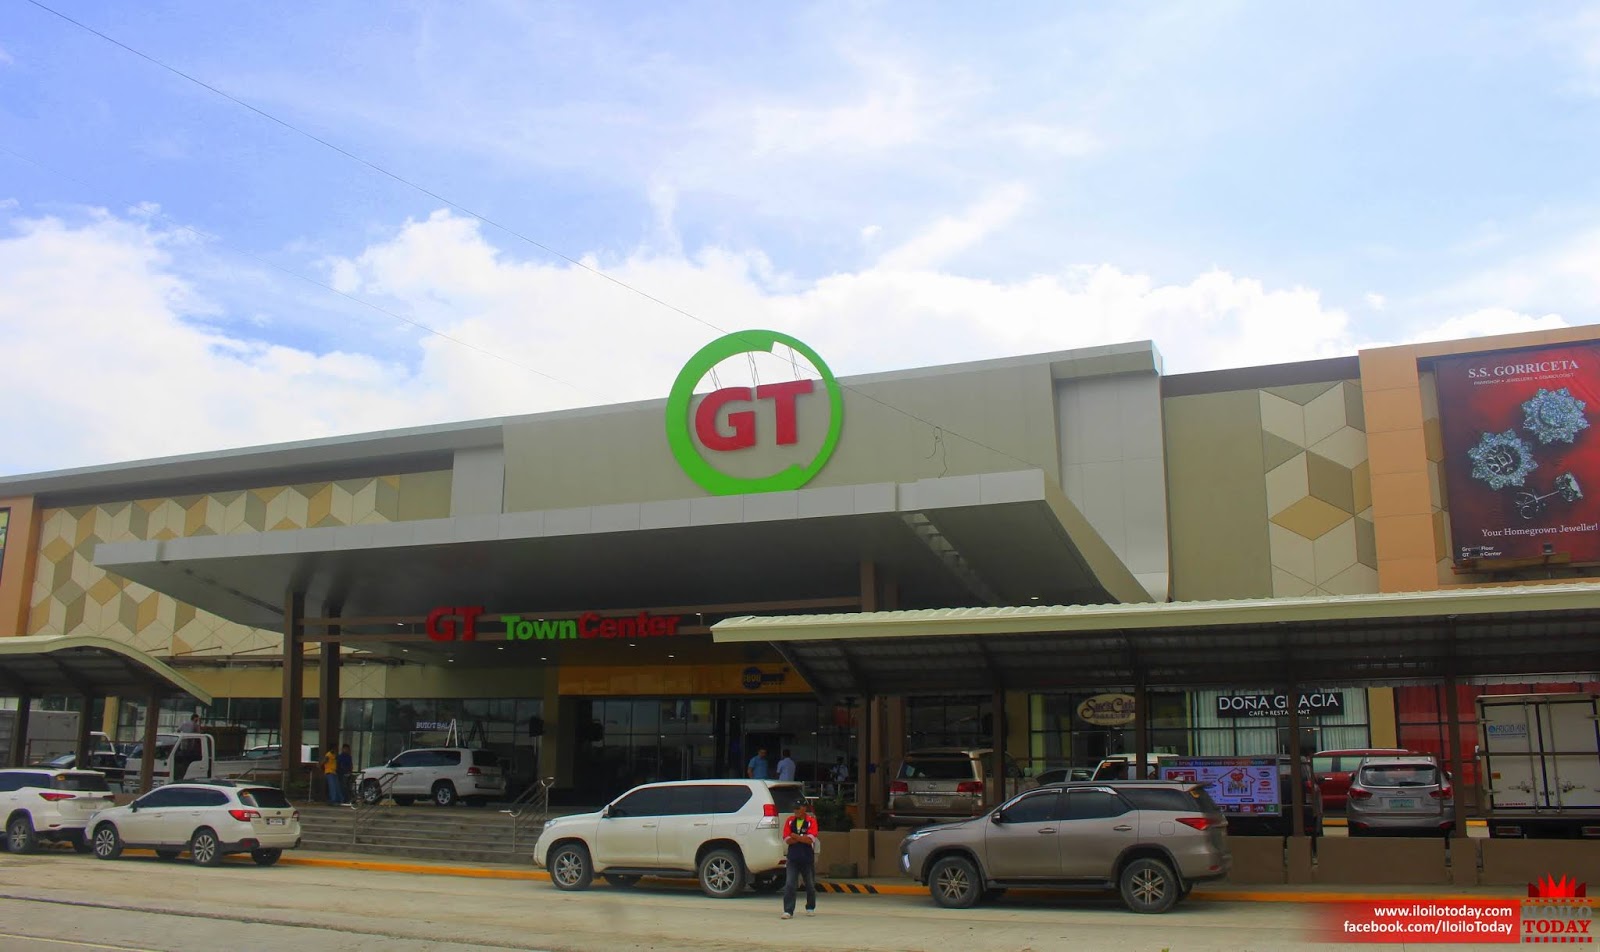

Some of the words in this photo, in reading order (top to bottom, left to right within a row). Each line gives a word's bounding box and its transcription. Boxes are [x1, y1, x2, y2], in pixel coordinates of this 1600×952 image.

[1468, 367, 1491, 378] S.S.
[1493, 360, 1579, 376] GORRICETA
[695, 379, 813, 451] GT
[1482, 529, 1502, 538] Your
[1504, 526, 1557, 538] Homegrown
[1559, 523, 1598, 534] Jeweller!
[425, 605, 484, 641] GT
[1218, 695, 1270, 710] DOÑA
[1274, 693, 1339, 709] GACIA
[1269, 709, 1311, 717] RESTAANT
